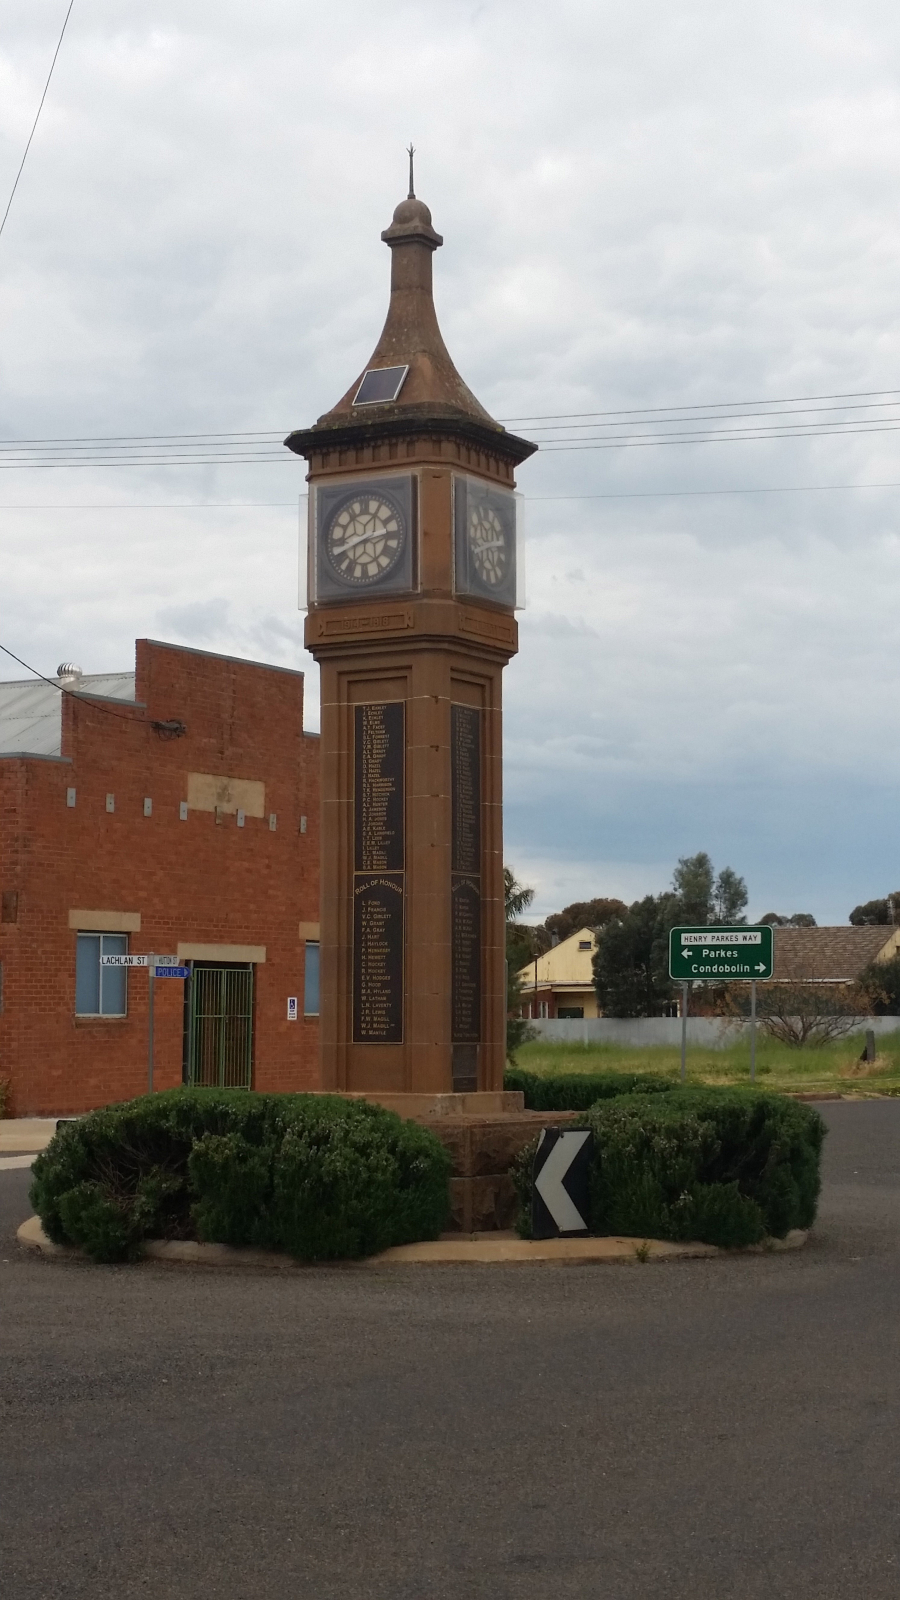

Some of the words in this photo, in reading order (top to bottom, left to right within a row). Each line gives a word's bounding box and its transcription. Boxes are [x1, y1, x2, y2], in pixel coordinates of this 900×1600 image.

[355, 883, 370, 895] ROLL
[379, 878, 403, 894] HONOUR
[702, 949, 738, 958] Parkes
[101, 956, 133, 965] LACHLAN
[137, 956, 145, 965] ST
[157, 968, 181, 977] POLICE
[691, 964, 750, 973] Condobolin
